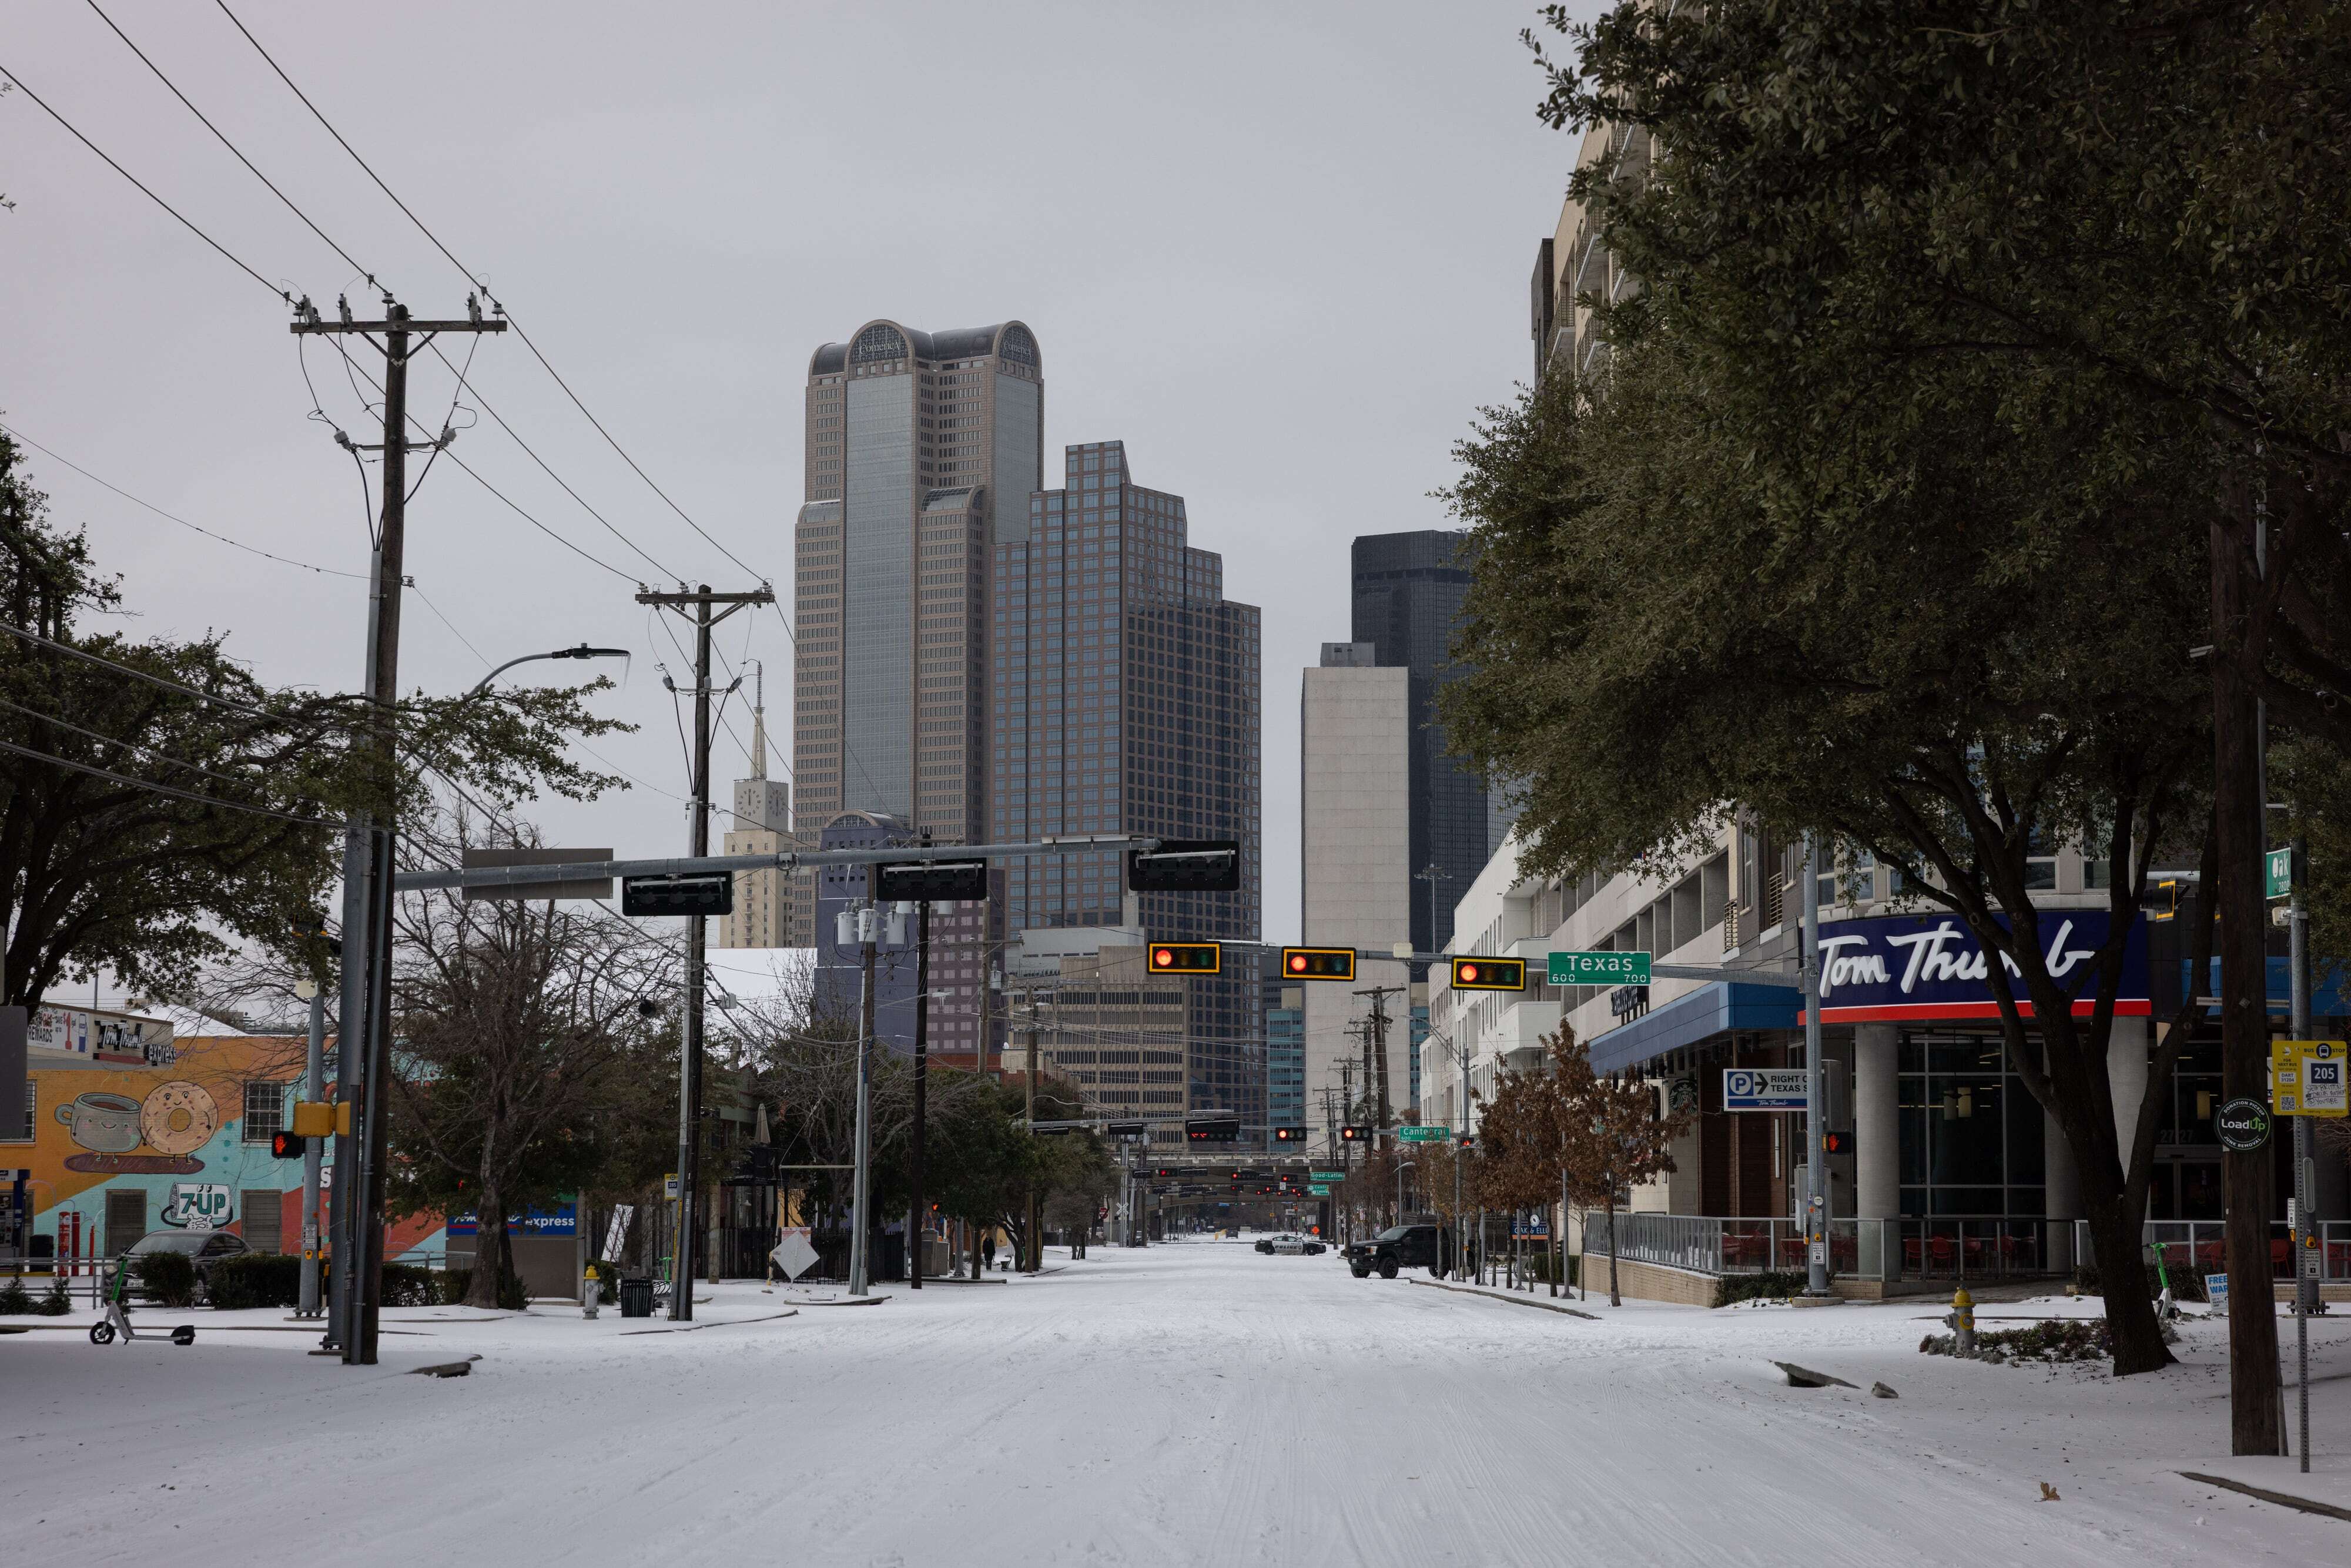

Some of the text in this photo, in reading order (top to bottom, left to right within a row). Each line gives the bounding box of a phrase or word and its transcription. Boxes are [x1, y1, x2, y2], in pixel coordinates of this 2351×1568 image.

[2272, 853, 2288, 878] Oak
[2279, 880, 2289, 892] 2800
[1567, 955, 1633, 971] Texas
[1818, 934, 1891, 998] Tom
[1552, 974, 1575, 982] 600
[28, 1025, 52, 1043] REWARDS
[94, 1020, 117, 1049] Tom
[147, 1044, 176, 1066] express
[2315, 1068, 2335, 1079] 205
[1736, 1077, 1747, 1091] P
[2223, 1101, 2265, 1115] DONATION PICKUP
[2221, 1117, 2266, 1133] LoadUp
[2224, 1135, 2262, 1148] JUNK REMOVAL
[525, 1217, 574, 1228] express
